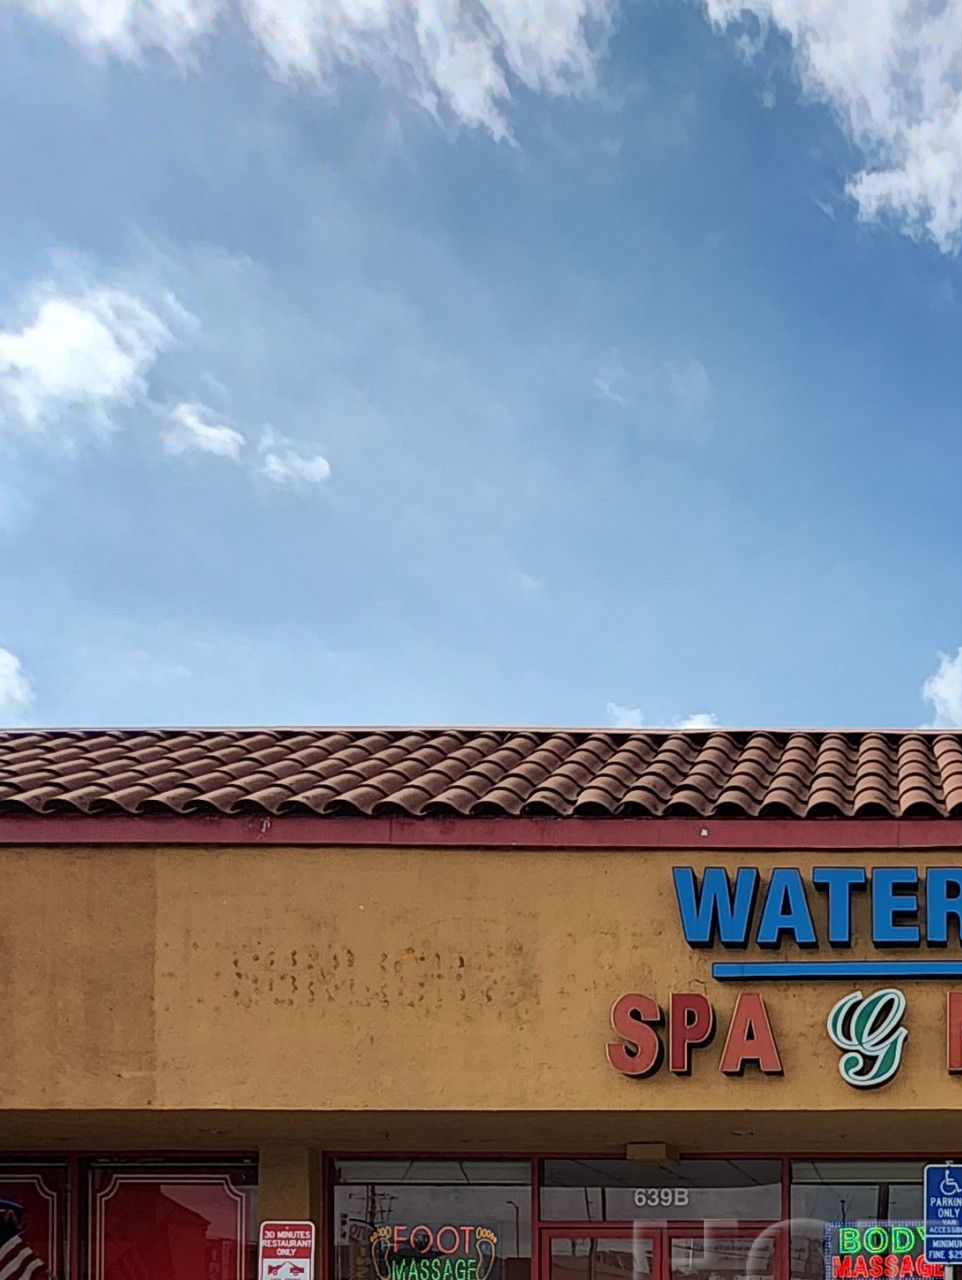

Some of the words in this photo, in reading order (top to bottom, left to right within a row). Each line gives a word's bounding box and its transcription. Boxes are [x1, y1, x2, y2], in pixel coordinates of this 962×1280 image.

[605, 991, 785, 1076] SPA
[633, 1188, 690, 1206] 639B
[937, 1208, 960, 1218] ONLY
[264, 1231, 275, 1239] 30
[277, 1231, 311, 1239] MINUTES
[260, 1239, 312, 1248] RESTAURANT
[393, 1225, 475, 1255] FOOT
[275, 1248, 297, 1256] ONLY
[928, 1250, 946, 1259] FINE
